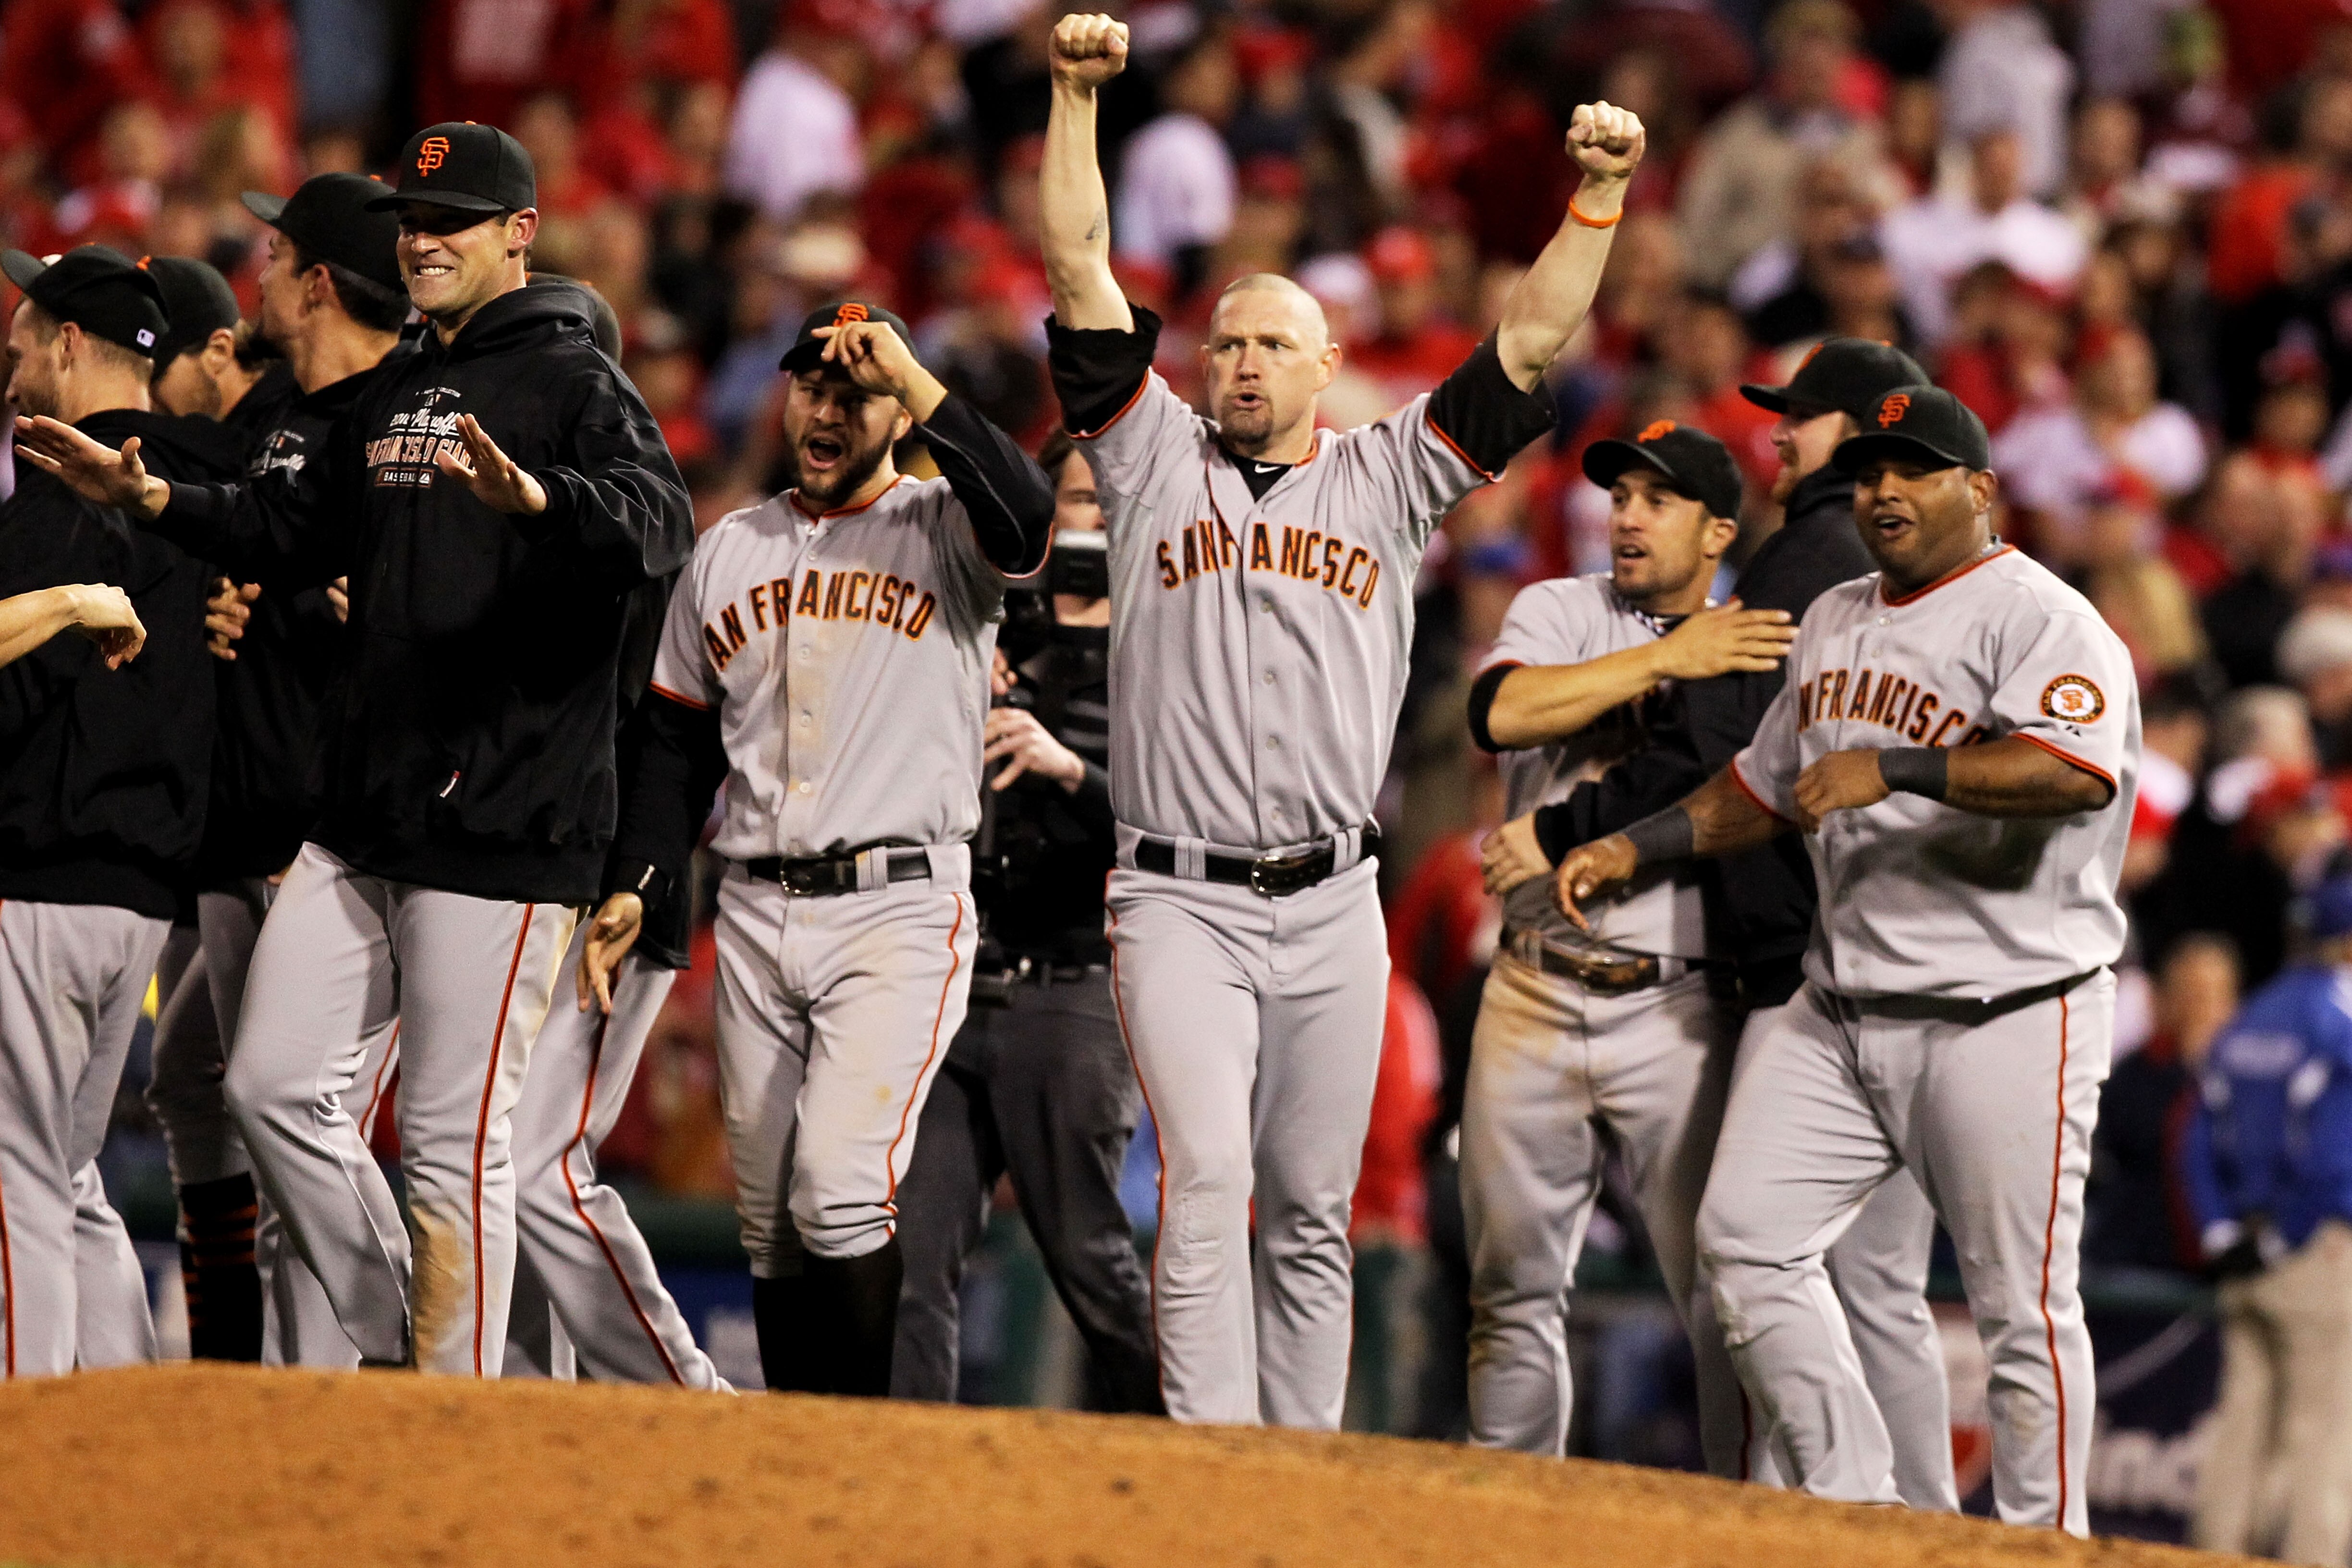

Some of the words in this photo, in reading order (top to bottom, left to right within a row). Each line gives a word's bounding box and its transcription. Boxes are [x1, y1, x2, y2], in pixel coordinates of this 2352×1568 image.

[416, 137, 450, 177] SF
[1156, 519, 1219, 590] SAN
[1217, 522, 1380, 611] FANCSCO
[748, 568, 936, 642] FRANCISCO
